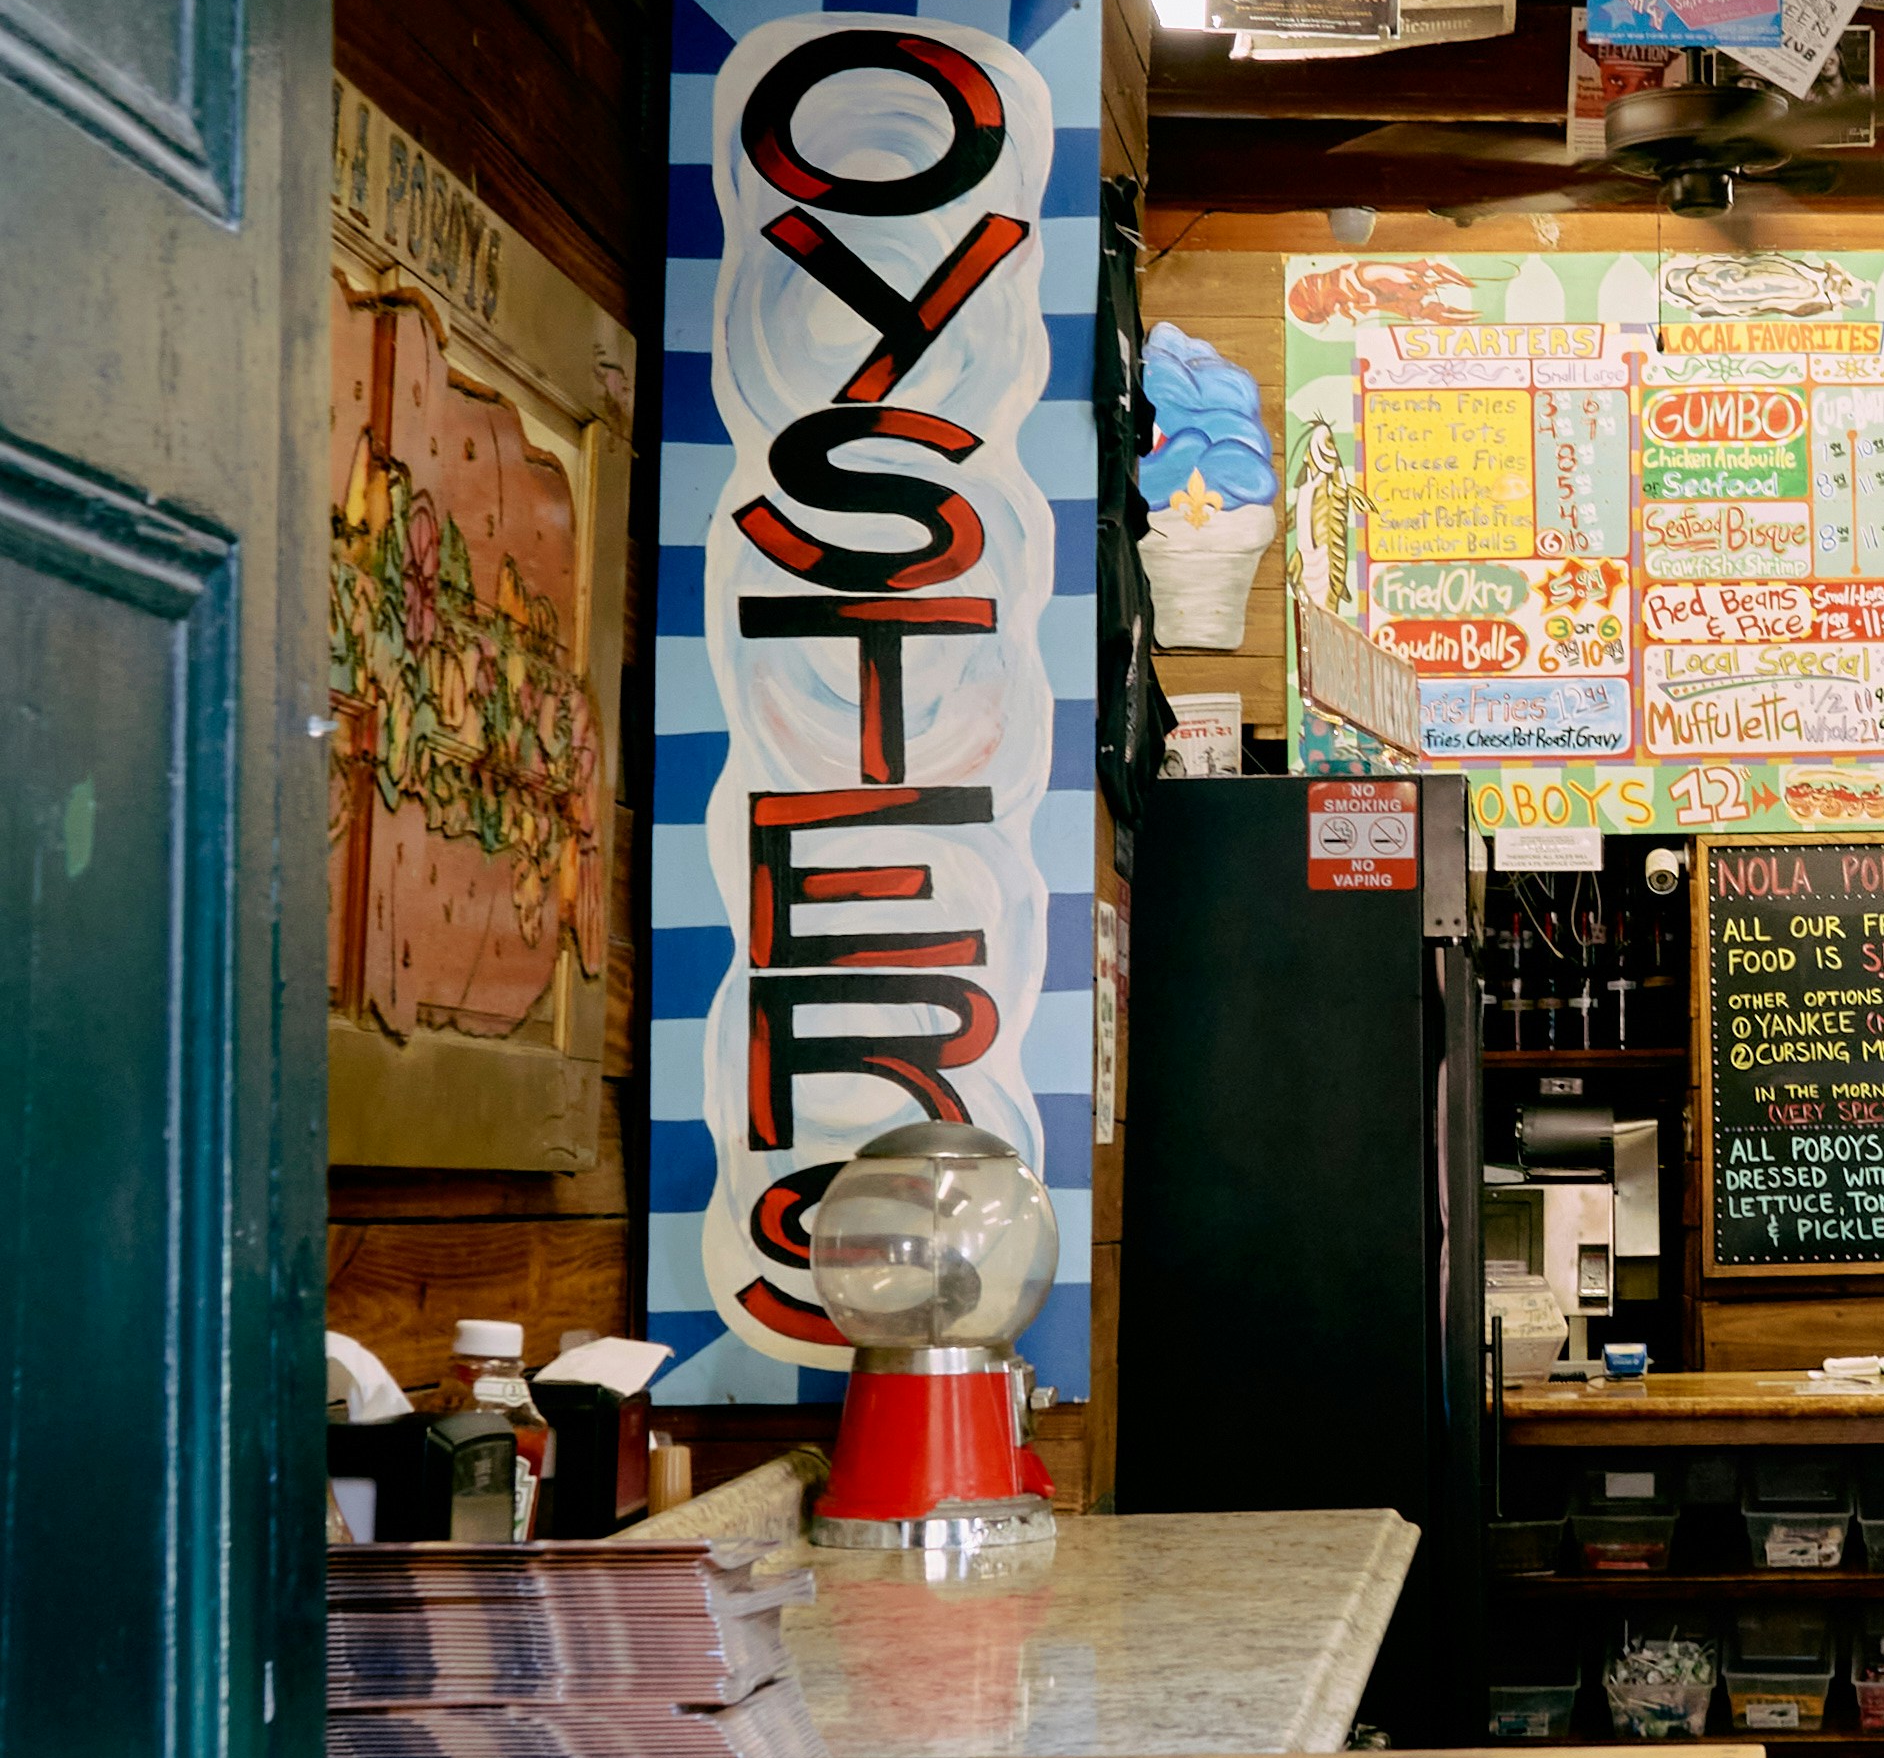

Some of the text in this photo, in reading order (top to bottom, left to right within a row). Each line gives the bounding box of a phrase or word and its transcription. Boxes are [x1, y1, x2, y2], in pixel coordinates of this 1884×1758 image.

[1405, 327, 1595, 357] STARTERS
[1663, 323, 1879, 353] LOCAL FAVORITES
[1650, 393, 1795, 439] GUMBO
[731, 28, 1030, 1347] OYSTERS
[1650, 693, 1803, 746] Muffuletta
[1323, 799, 1402, 812] SMOKING
[1351, 784, 1376, 798] NO
[1333, 873, 1393, 887] VAPING
[1351, 859, 1375, 872] NO
[1717, 856, 1812, 896] NOLA
[1723, 917, 1772, 943] ALL
[1790, 915, 1846, 939] OUR
[1728, 948, 1796, 975] FOOD
[1816, 946, 1843, 970] IS
[1730, 1137, 1775, 1164] ALL
[1791, 1134, 1883, 1162] POBOYS
[1725, 1167, 1827, 1191] DRESSED
